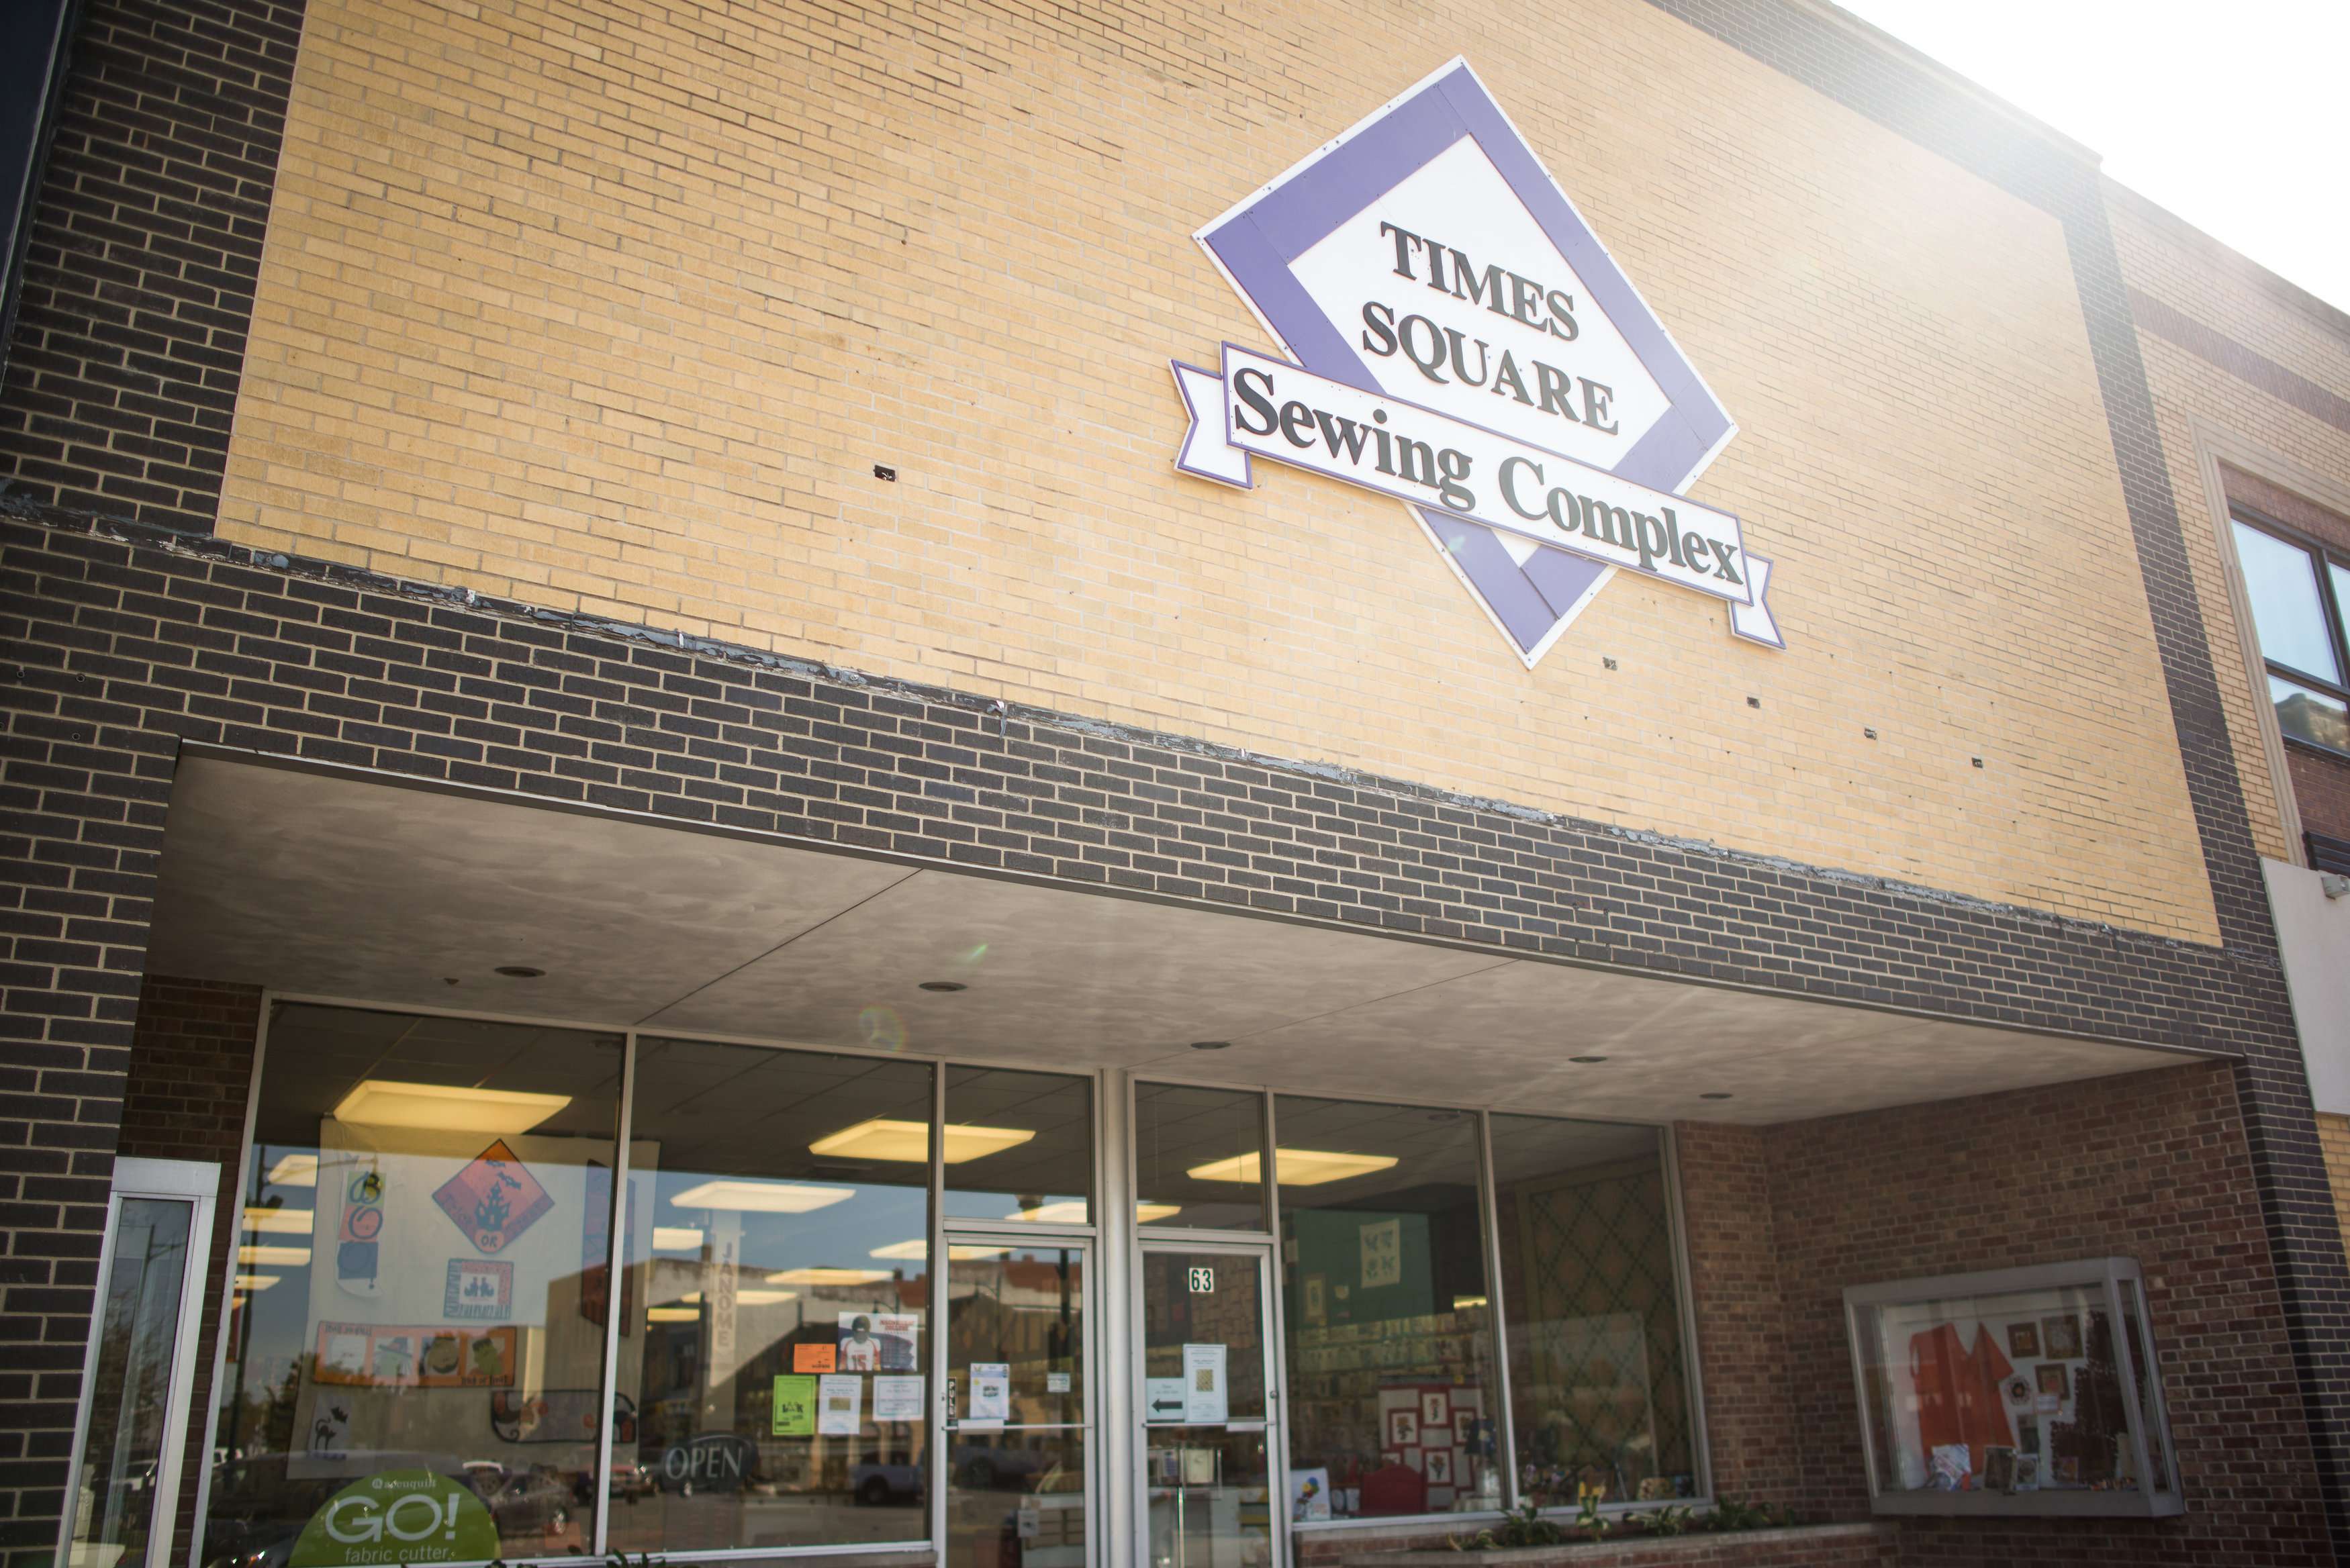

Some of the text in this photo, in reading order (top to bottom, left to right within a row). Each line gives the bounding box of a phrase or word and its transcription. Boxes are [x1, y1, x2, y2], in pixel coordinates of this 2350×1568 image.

[1381, 221, 1579, 341] TIMES
[1362, 301, 1619, 436] SQUARE
[1233, 367, 1743, 585] Sewing Complex
[718, 1242, 733, 1346] JANOME
[1191, 1269, 1211, 1291] 63
[665, 1447, 742, 1479] OPEN
[325, 1493, 460, 1543] GO!
[344, 1547, 393, 1563] fabric
